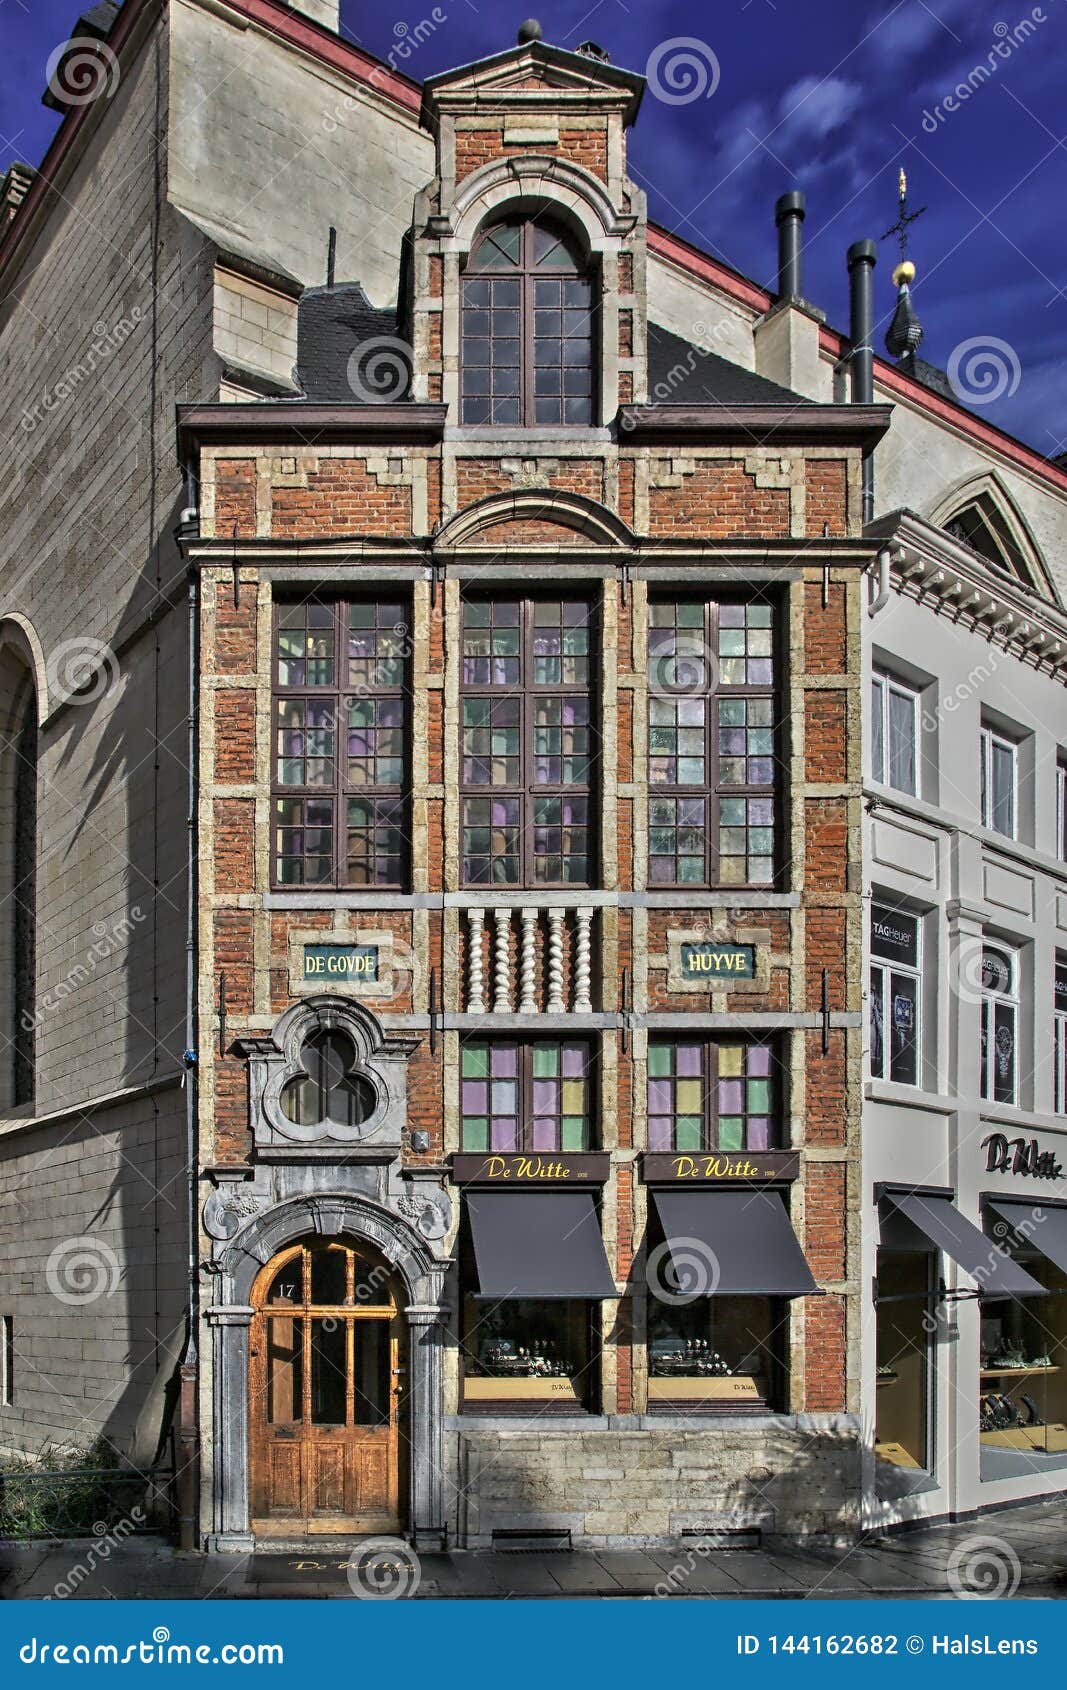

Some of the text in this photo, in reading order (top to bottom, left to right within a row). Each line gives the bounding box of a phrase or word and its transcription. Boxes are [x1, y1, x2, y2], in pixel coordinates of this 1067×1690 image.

[305, 956, 325, 973] DE
[688, 953, 746, 971] HUYVE
[981, 1133, 1012, 1174] De
[483, 1156, 571, 1178] De Witte
[672, 1155, 758, 1177] De Witte
[279, 1283, 295, 1297] 17
